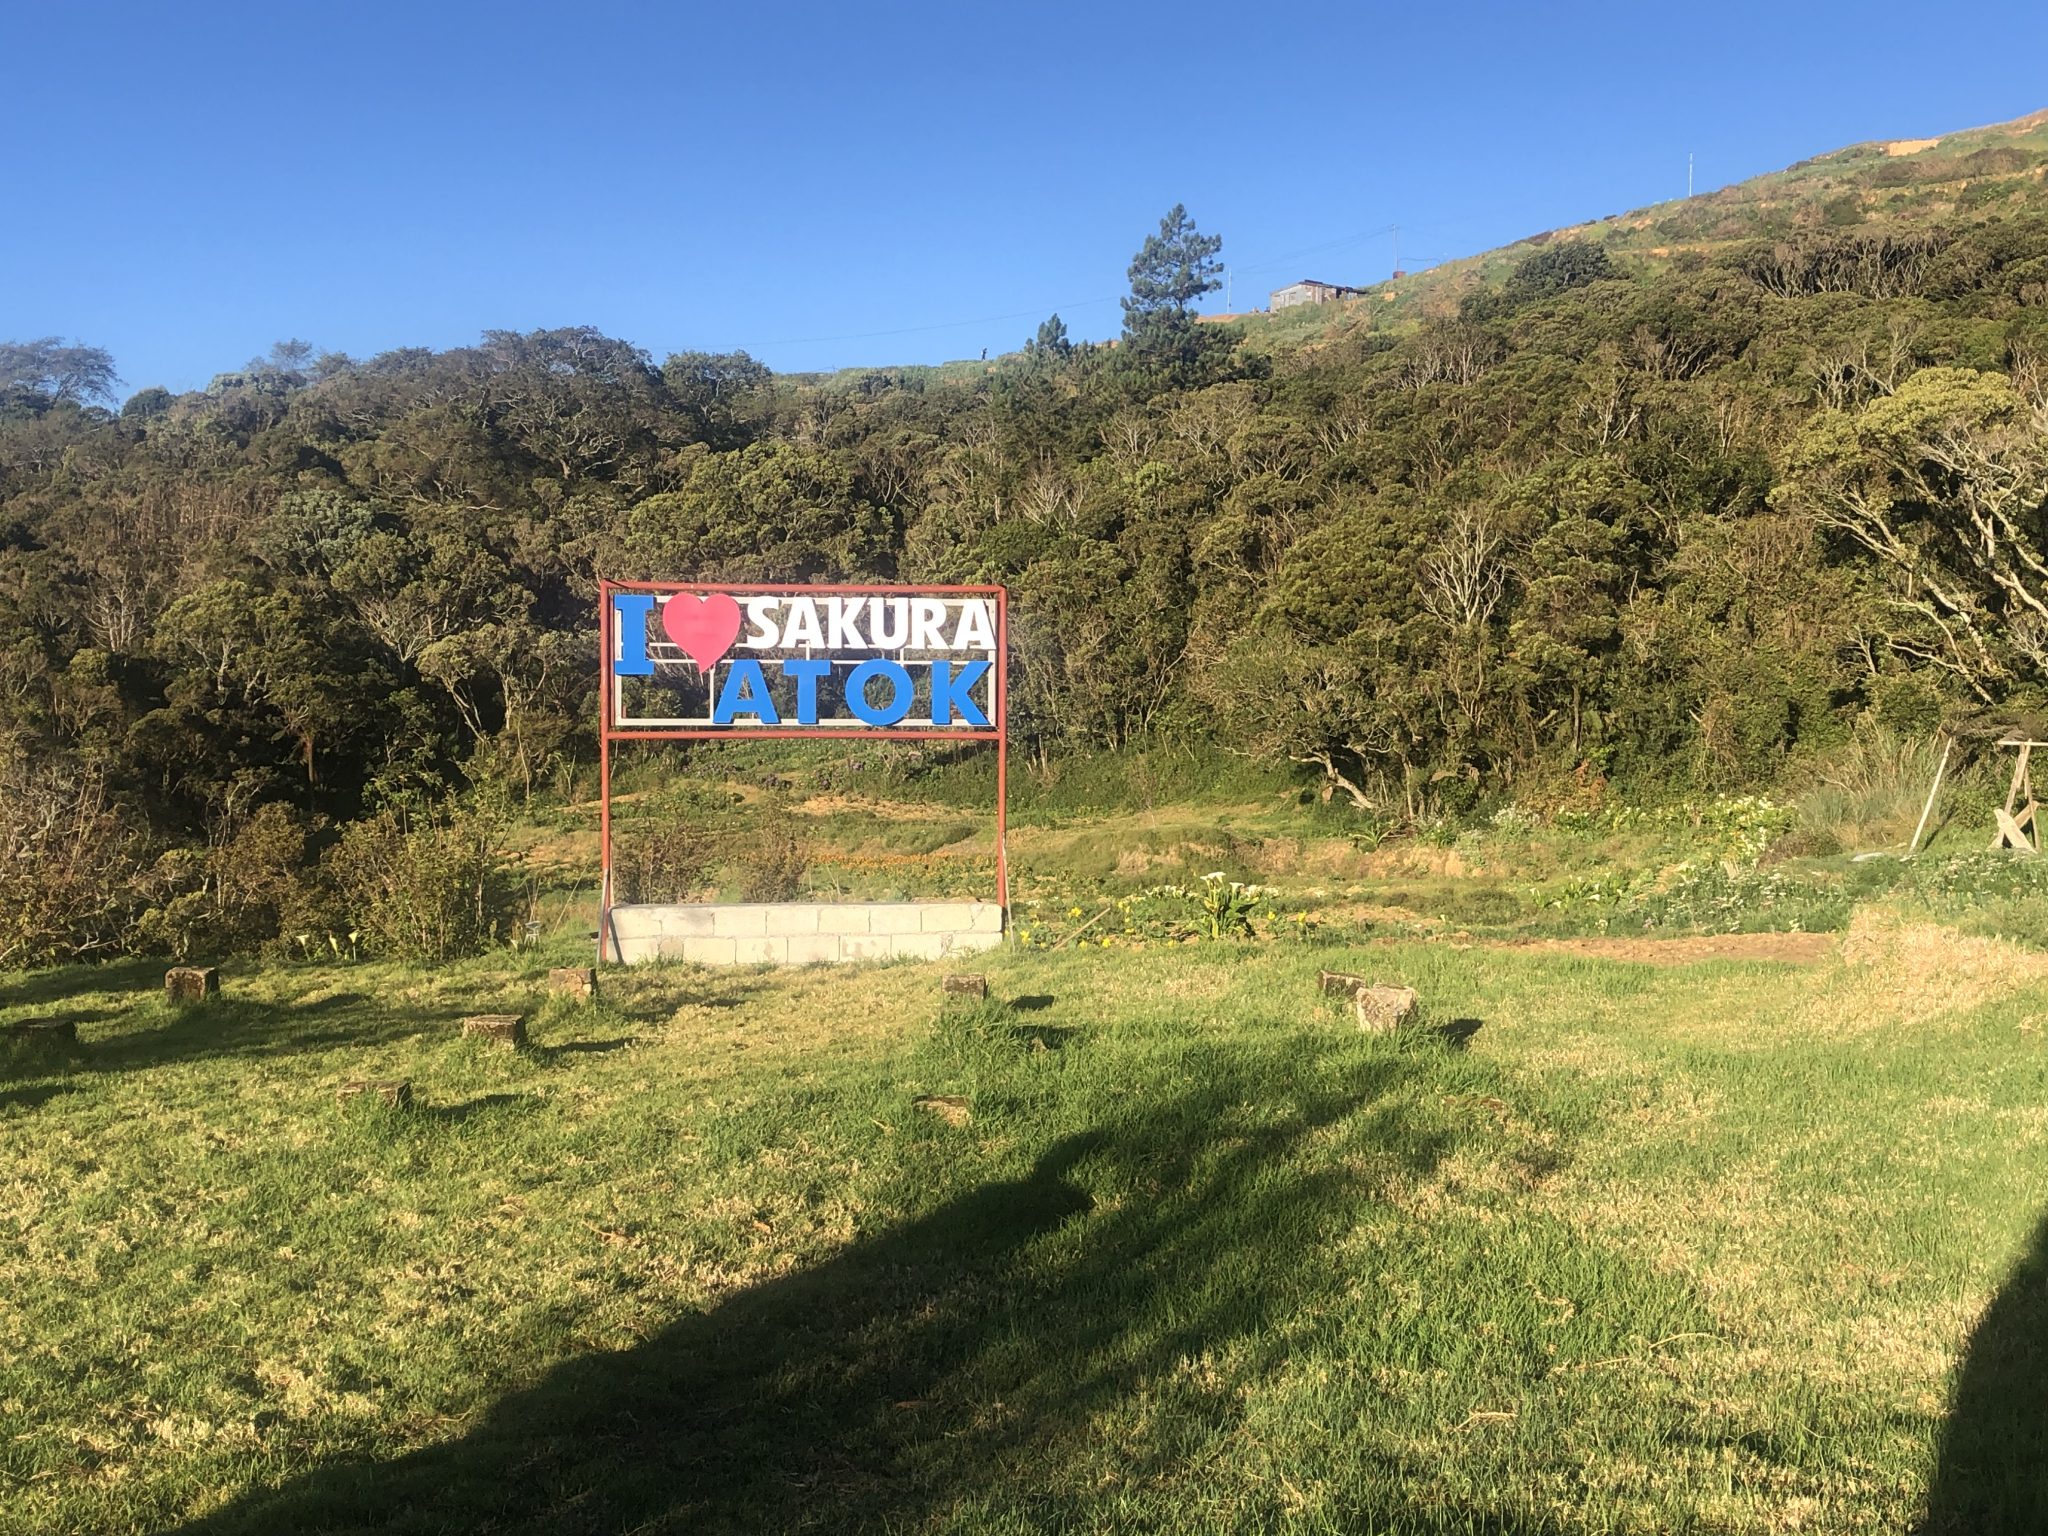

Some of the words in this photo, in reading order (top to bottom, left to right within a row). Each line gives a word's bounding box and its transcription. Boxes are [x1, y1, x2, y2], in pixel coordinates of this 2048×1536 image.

[614, 594, 654, 675] I
[746, 595, 997, 650] SAKURA
[713, 659, 993, 726] ATOK
